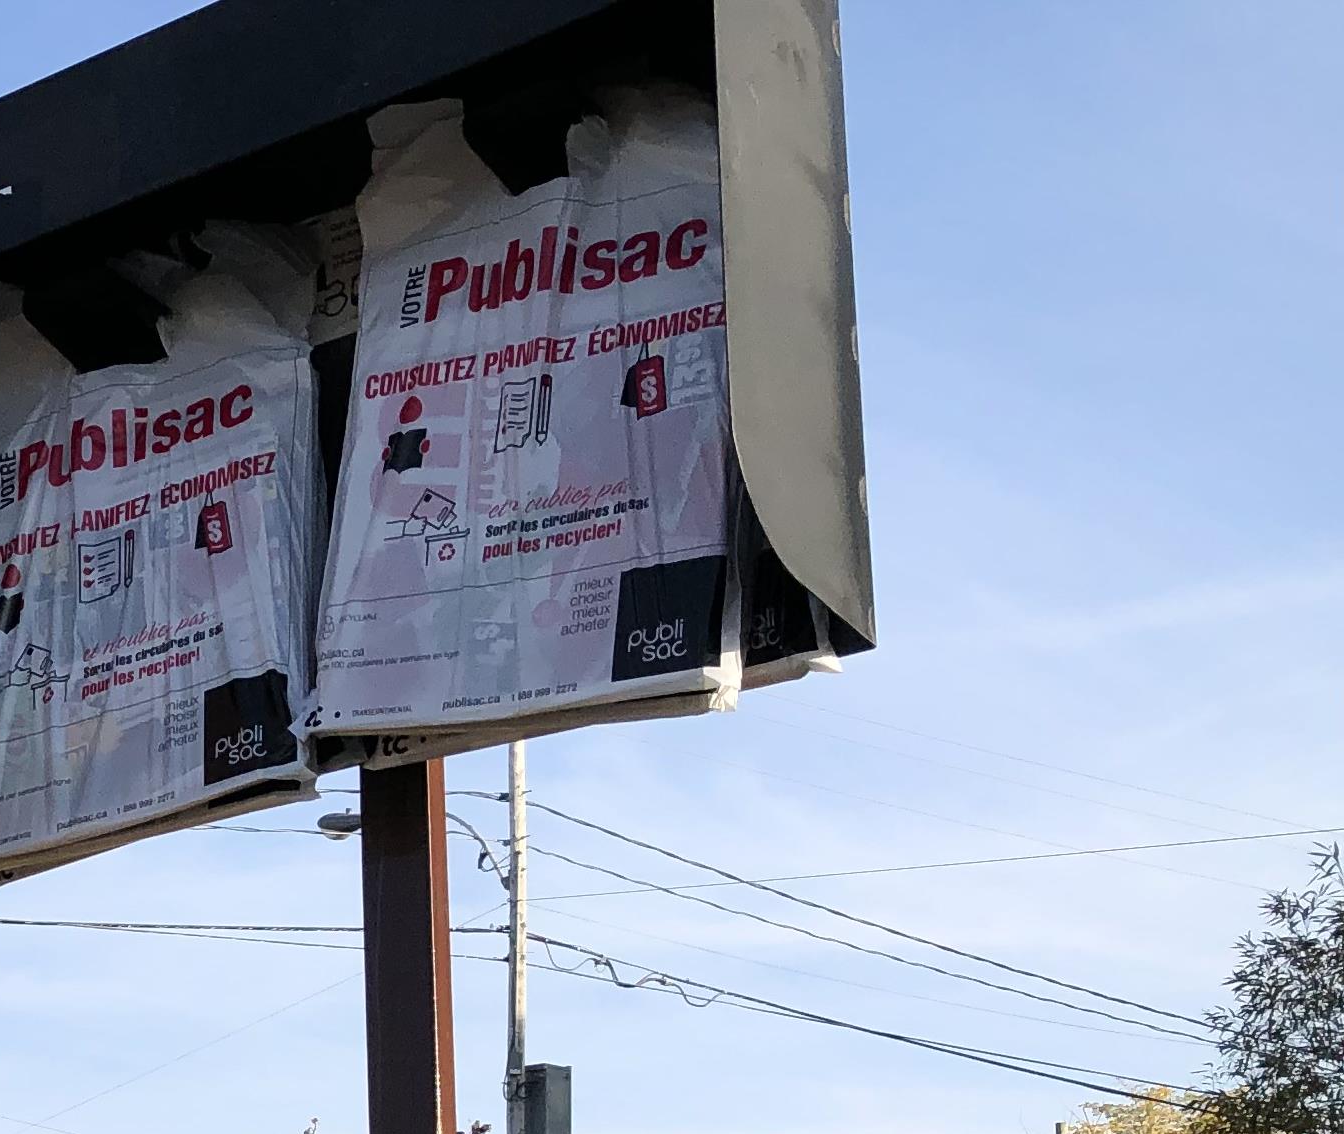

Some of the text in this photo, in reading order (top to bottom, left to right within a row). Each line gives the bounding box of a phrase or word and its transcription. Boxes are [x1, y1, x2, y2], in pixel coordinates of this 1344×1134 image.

[424, 218, 709, 324] Publisac
[400, 263, 426, 329] VOTRE
[365, 355, 476, 400] CONSULTEZ
[17, 384, 254, 502] Publisac
[0, 449, 17, 511] VOTRE
[160, 451, 277, 509] ÉCONOMISEZ
[485, 497, 650, 538] Sortz les circulaires du sac
[517, 536, 541, 554] les
[545, 518, 622, 550] recycler!
[569, 589, 613, 607] choisir
[574, 576, 615, 592] mieux
[560, 617, 611, 637] acheter
[572, 604, 612, 621] mieux
[115, 654, 133, 667] les
[193, 630, 206, 643] du
[627, 618, 685, 653] publi
[641, 639, 688, 662] sac
[81, 646, 201, 700] pour les recycler!
[442, 695, 501, 711] publisac.ca
[214, 724, 263, 759] publi
[228, 741, 267, 765] sac
